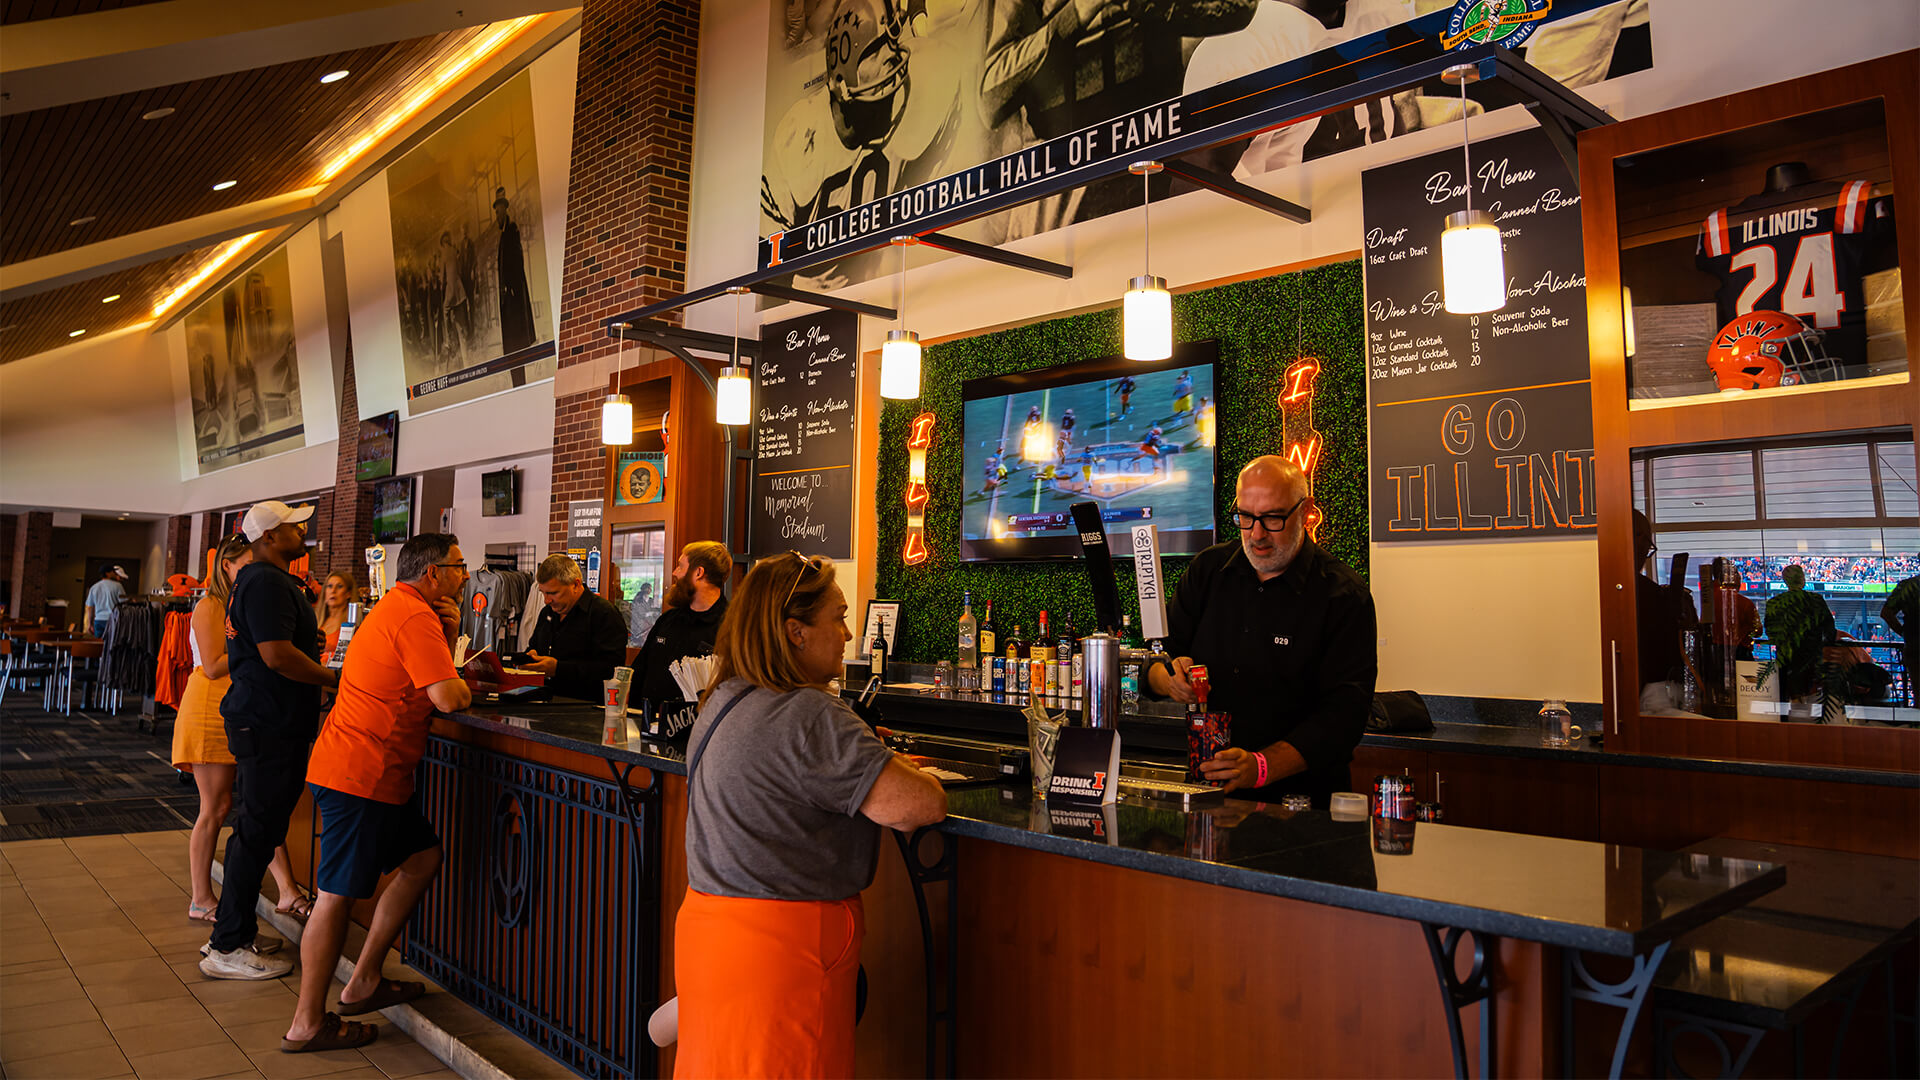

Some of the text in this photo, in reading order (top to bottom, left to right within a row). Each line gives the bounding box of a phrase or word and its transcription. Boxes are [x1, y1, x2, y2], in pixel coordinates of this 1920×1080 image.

[1503, 14, 1533, 22] INDIANA
[1449, 32, 1468, 46] SOUTH
[1505, 22, 1534, 49] FAME
[830, 30, 851, 70] 50
[806, 203, 881, 251] COLLEGE
[889, 168, 990, 225] FOOTBALL
[1000, 145, 1056, 189] HALL
[1069, 129, 1098, 166] OF
[1112, 101, 1181, 154] FAME
[1425, 158, 1536, 205] Bar Menu
[1488, 188, 1582, 223] Canned Beer
[1500, 227, 1521, 238] mestic
[1743, 207, 1818, 244] ILLINOIS
[1366, 227, 1408, 249] Draft
[1370, 246, 1428, 265] 16oz Craft Draft
[1729, 231, 1846, 329] 24
[1369, 297, 1407, 321] Wine
[1409, 304, 1417, 314] &
[1491, 305, 1550, 325] Souvenir Soda
[786, 326, 831, 351] Bar Menu
[1370, 315, 1480, 342] 9oz Wine 10
[1492, 317, 1569, 338] Non-Alcoholic Beer
[1718, 321, 1777, 350] ILLINI
[1372, 328, 1479, 355] 12oz Canned Cocktails 12
[1372, 342, 1480, 367] 12oz Standard Cocktails 13
[761, 362, 779, 376] Draft
[1371, 355, 1481, 380] 20oz Mason Jar Cocktails 20
[420, 380, 437, 395] GEORGE
[437, 376, 448, 390] HUFF
[760, 407, 775, 422] Wine
[1441, 397, 1527, 456] GO
[620, 452, 664, 460] ILLINOIS
[771, 474, 807, 491] WELCOME
[1386, 449, 1598, 532] ILLINI
[765, 488, 814, 519] Memorial
[781, 515, 828, 542] Stadium
[1056, 513, 1063, 522] 0
[1080, 532, 1102, 542] RIGGS
[1136, 548, 1156, 600] TRIPTYCH
[1274, 636, 1289, 645] 029
[1740, 685, 1769, 693] DECOY
[666, 705, 695, 738] JACK
[1050, 786, 1102, 797] RESPONSIBLY
[1052, 776, 1092, 788] DRINK
